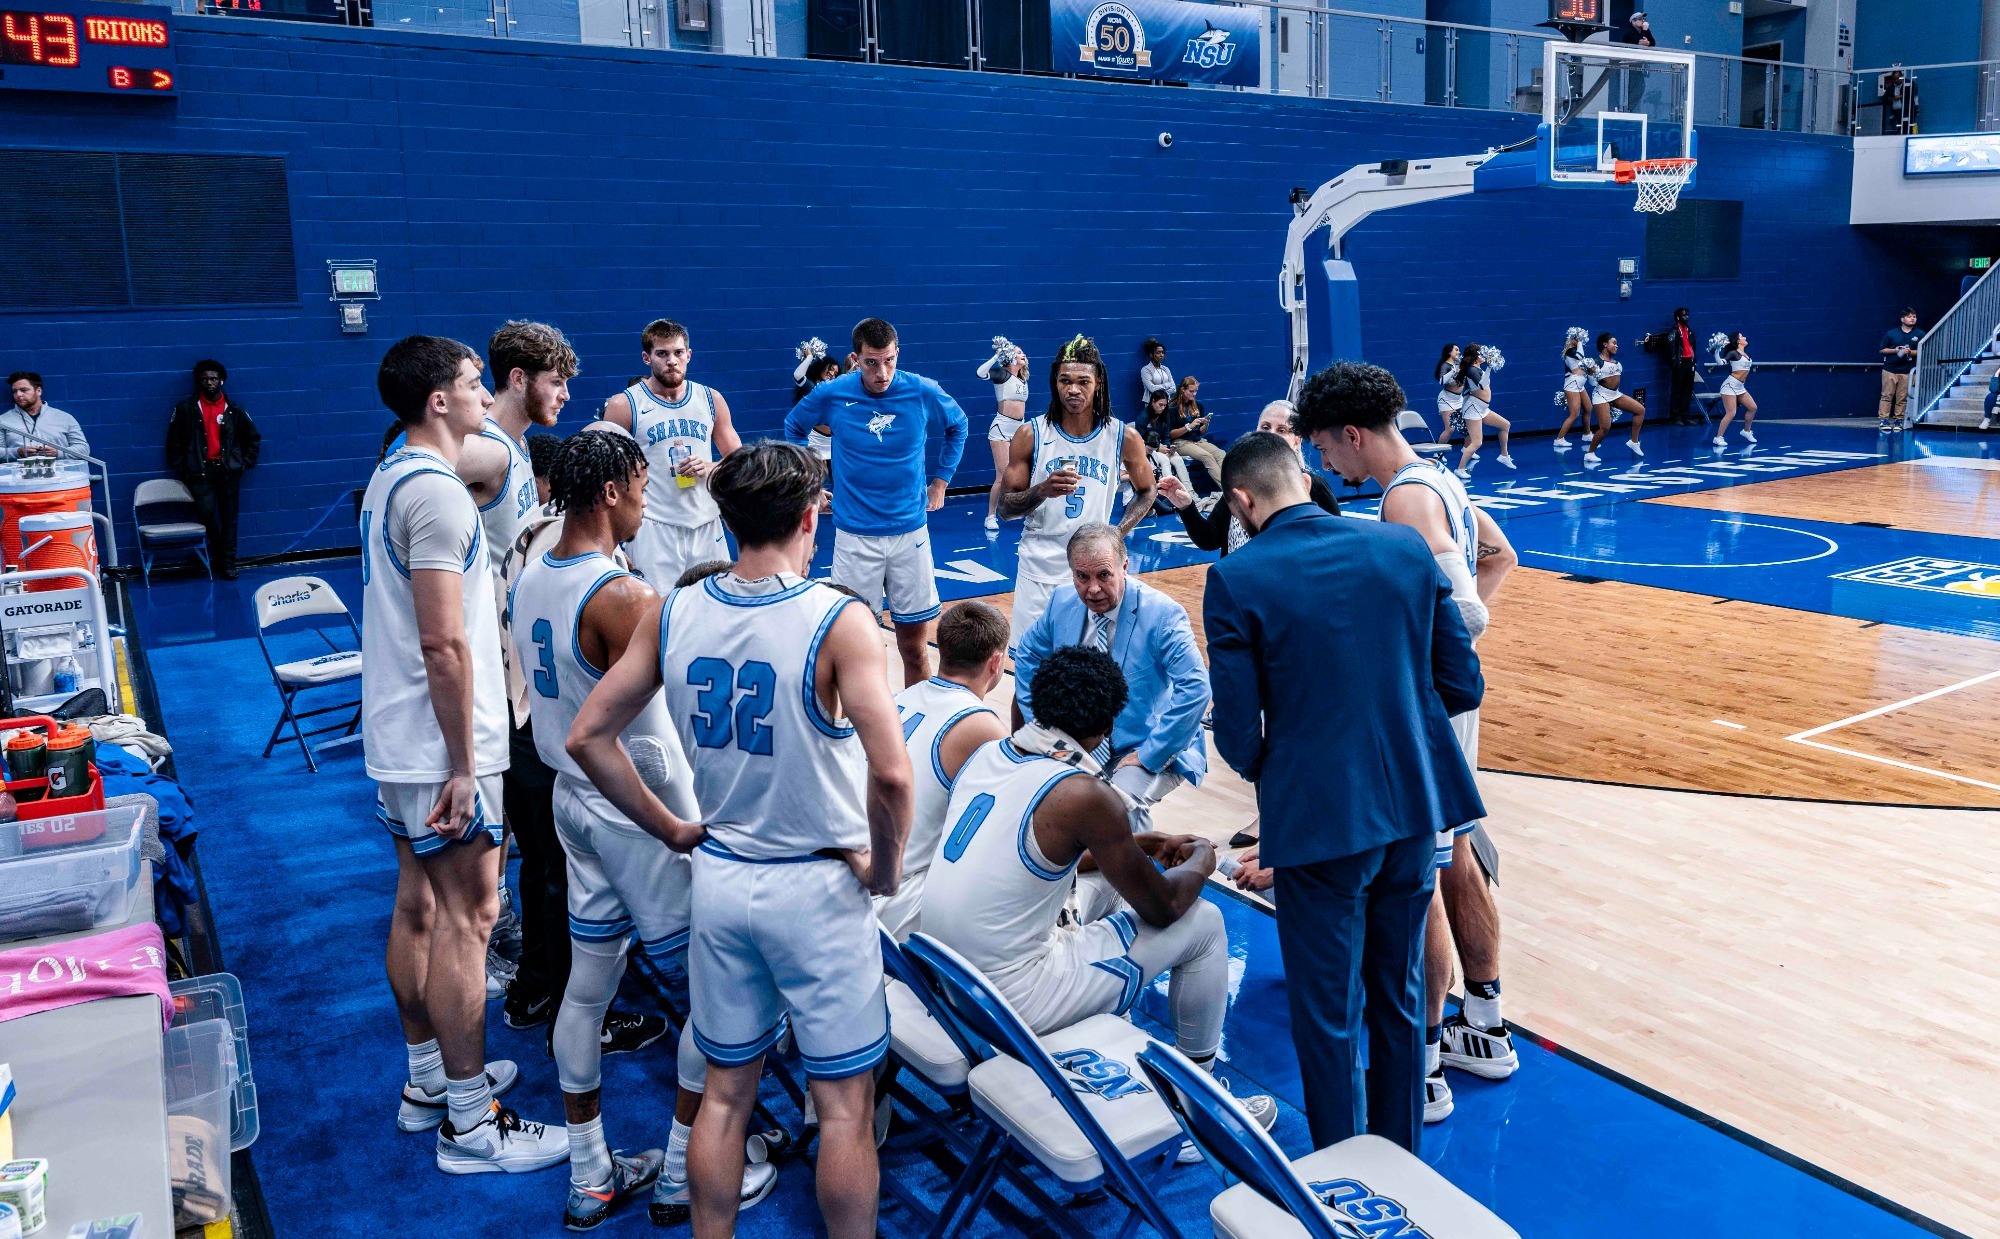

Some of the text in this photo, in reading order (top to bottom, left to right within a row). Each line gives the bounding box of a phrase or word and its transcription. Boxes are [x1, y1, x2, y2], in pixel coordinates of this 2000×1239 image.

[1098, 6, 1126, 16] DIVISION
[5, 15, 77, 64] 43
[86, 19, 165, 43] TRITONS
[1100, 25, 1129, 52] 50
[1182, 39, 1236, 68] NSU
[114, 69, 129, 86] B
[1974, 258, 1987, 268] EXIT
[342, 271, 368, 291] EXIT
[646, 418, 708, 447] SHARKS
[1045, 456, 1109, 486] SHRKS
[1065, 487, 1085, 519] 5
[4, 599, 83, 617] GATORADE
[268, 590, 311, 607] Sharks
[532, 617, 560, 700] 3
[687, 656, 777, 756] 32
[943, 792, 995, 864] 0
[1050, 1047, 1153, 1101] NSU
[185, 1134, 207, 1189] RADE
